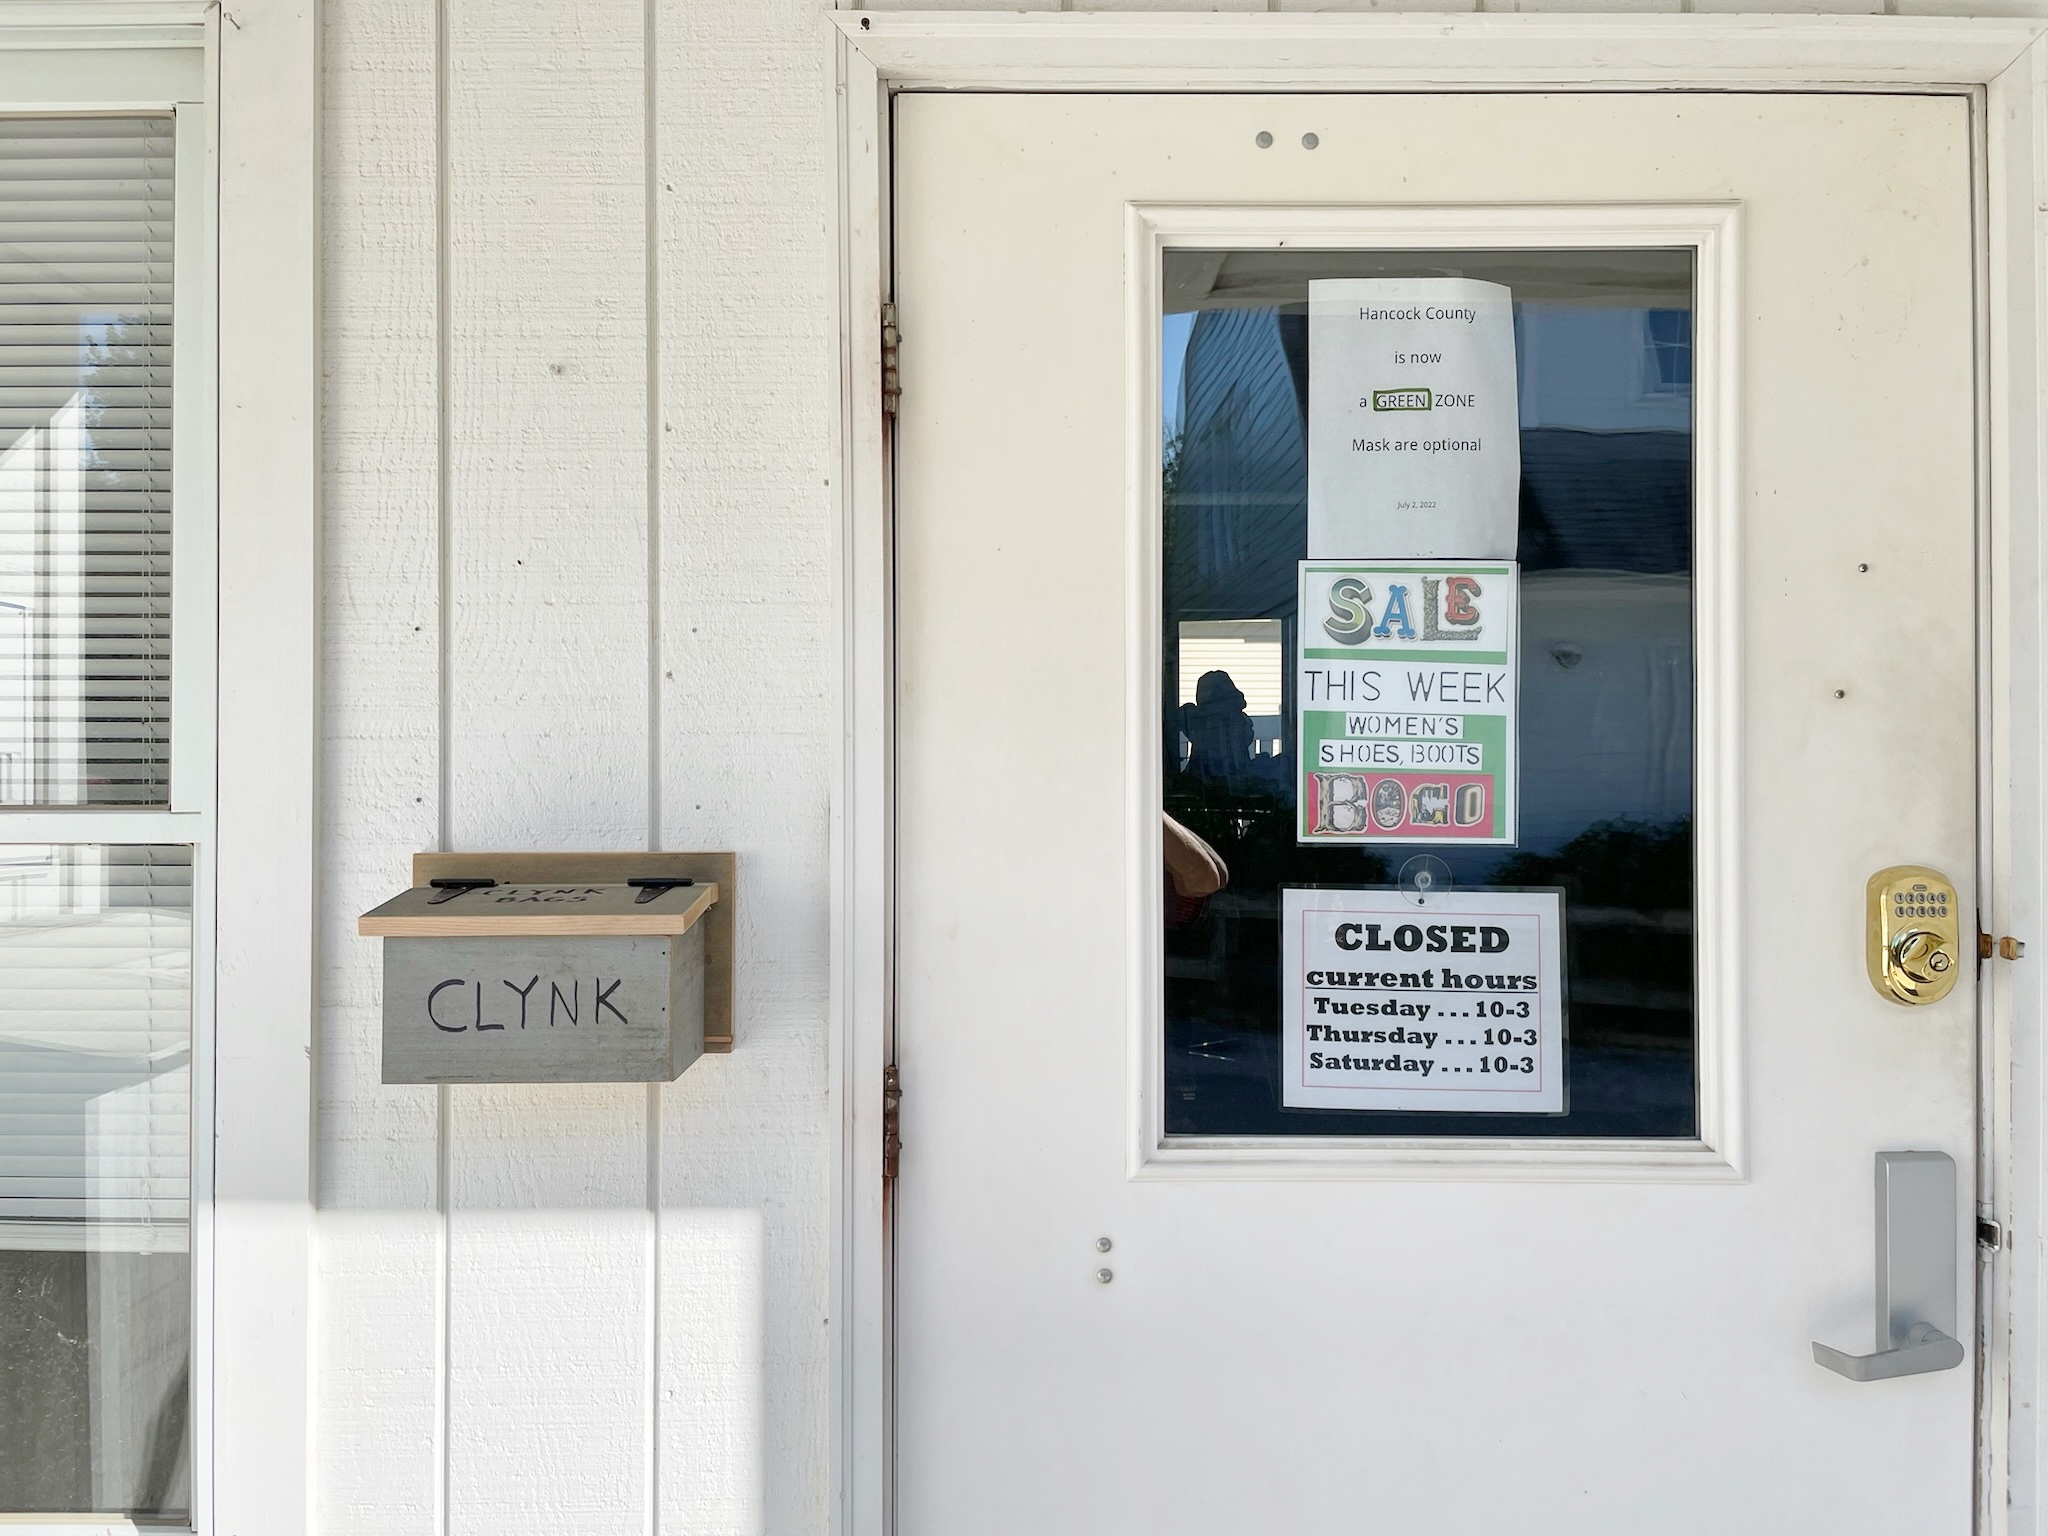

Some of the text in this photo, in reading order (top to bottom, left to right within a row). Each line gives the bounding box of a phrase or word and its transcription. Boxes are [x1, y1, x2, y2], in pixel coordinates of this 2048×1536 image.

[1359, 306, 1476, 324] Hancock County
[1394, 350, 1442, 364] is now
[1359, 394, 1475, 408] a GREEN ZONE
[1352, 438, 1482, 455] Mask are optional
[1397, 501, 1437, 510] July 2, 2022
[1322, 575, 1484, 646] SALE
[1304, 670, 1506, 703] THIS WEEK
[1349, 716, 1459, 736] WOMEN'S
[1320, 744, 1480, 766] SHOES, BOOTS
[1312, 772, 1486, 834] BOGO
[482, 888, 606, 896] CLYNK
[1334, 923, 1510, 954] CLOSED
[1306, 968, 1538, 990] current hours
[427, 974, 628, 1032] CLYNK
[1313, 997, 1431, 1021] Tuesday
[1476, 1001, 1530, 1018] 10-3
[1306, 1024, 1438, 1049] Thursday
[1484, 1028, 1538, 1046] 10-3
[1309, 1052, 1435, 1077] Saturday
[1480, 1056, 1534, 1073] 10-3
